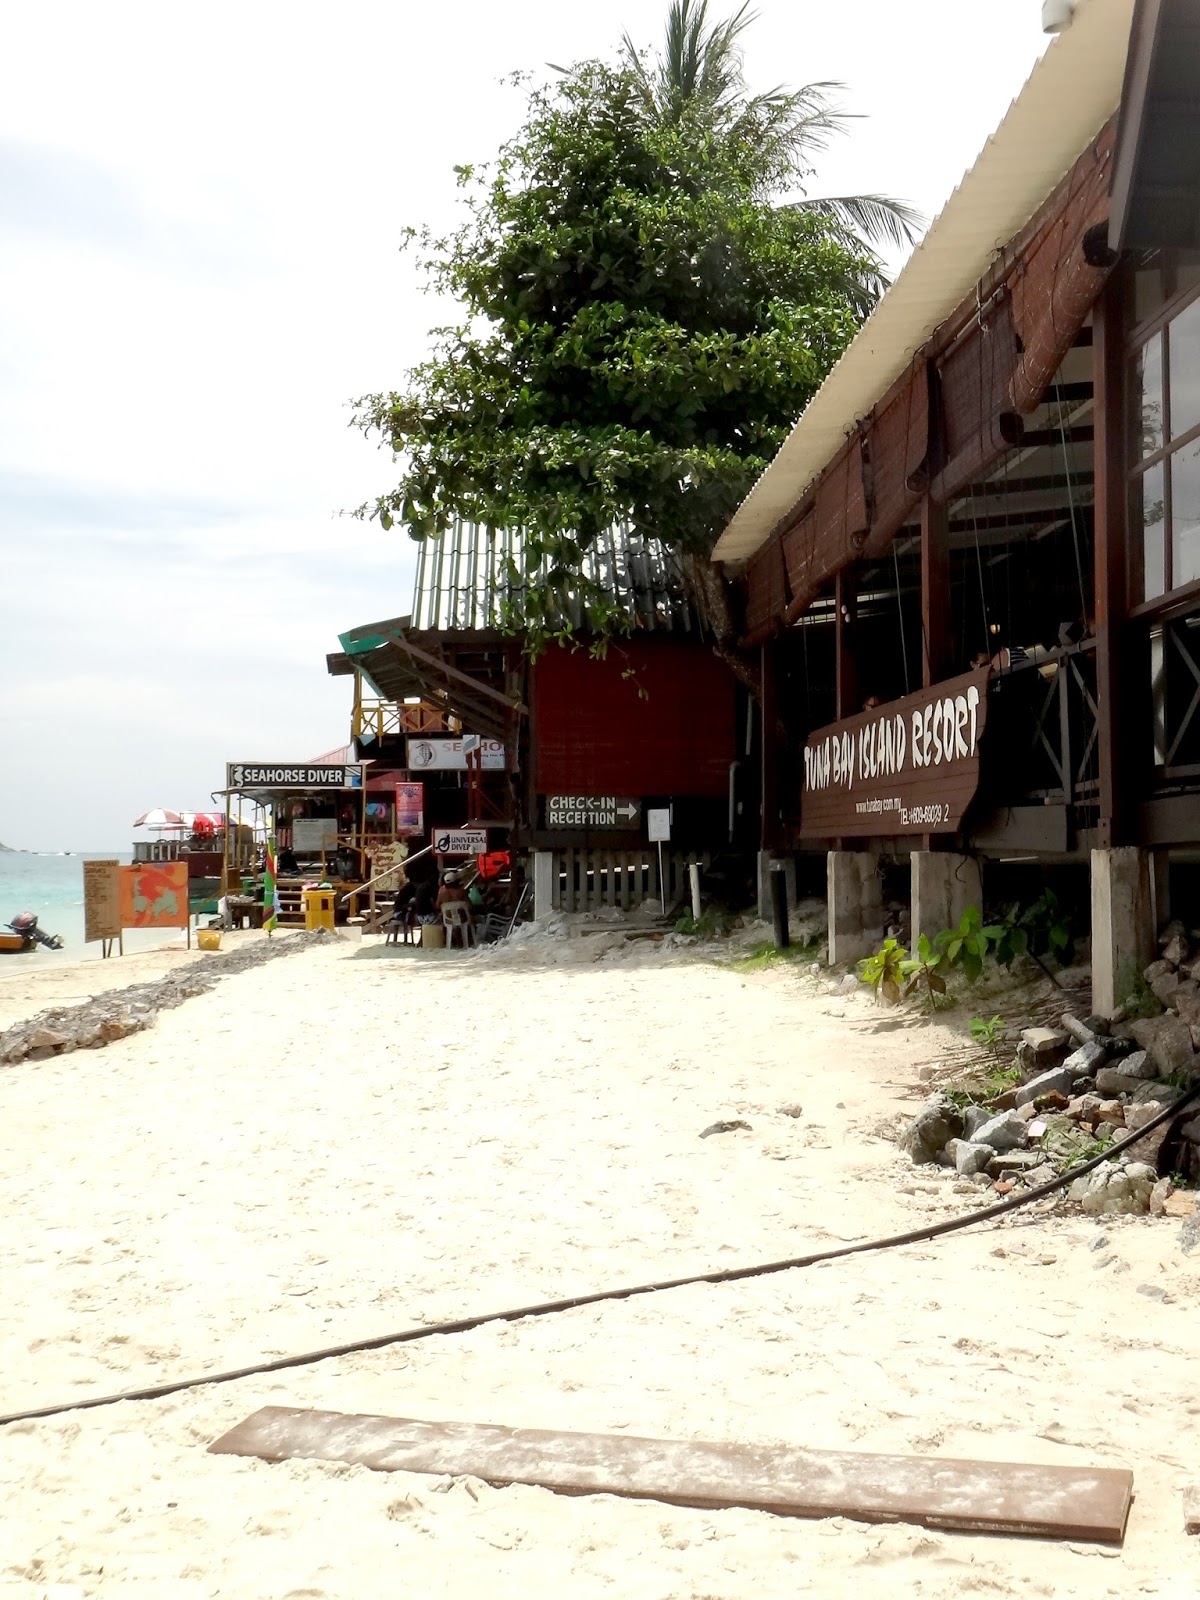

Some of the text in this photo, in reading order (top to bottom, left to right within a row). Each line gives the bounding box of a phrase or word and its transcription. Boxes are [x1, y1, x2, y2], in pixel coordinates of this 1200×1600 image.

[804, 686, 979, 792] TUNA BAY ISLAND RESORT
[244, 768, 343, 783] SEAHORSE DIVER
[549, 797, 616, 809] CHECK-IN
[549, 812, 616, 825] RECEPTION
